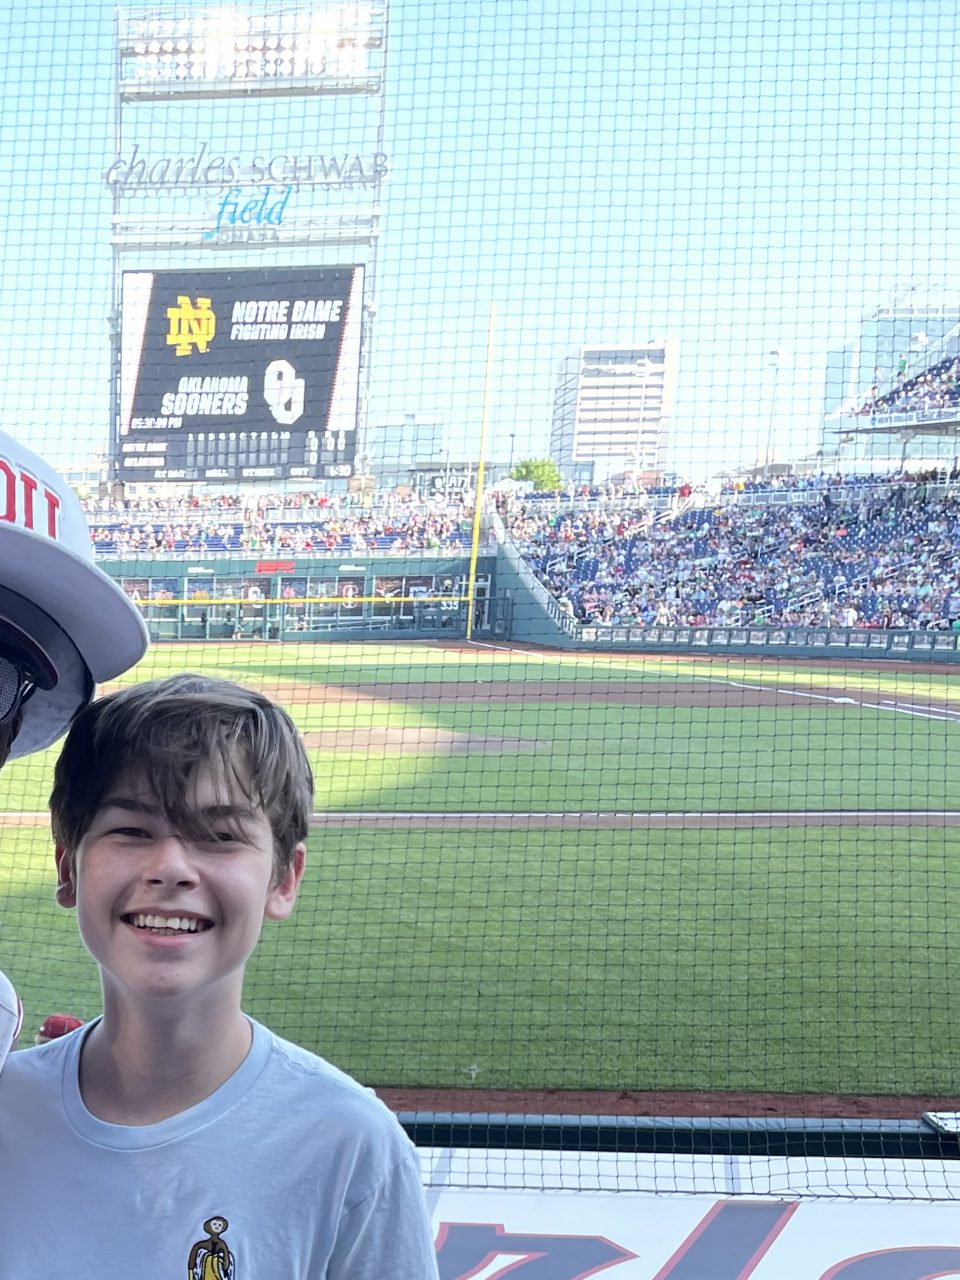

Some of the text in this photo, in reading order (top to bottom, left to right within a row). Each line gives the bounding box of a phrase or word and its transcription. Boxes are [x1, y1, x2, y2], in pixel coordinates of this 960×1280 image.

[251, 152, 388, 182] SCHWAB
[203, 184, 292, 239] field
[231, 299, 343, 323] NOTRE DAME
[230, 322, 326, 341] FIGHTING IRISH
[178, 376, 248, 393] OKLAHOMA
[161, 392, 249, 415] SOONERS
[440, 600, 459, 611] 335
